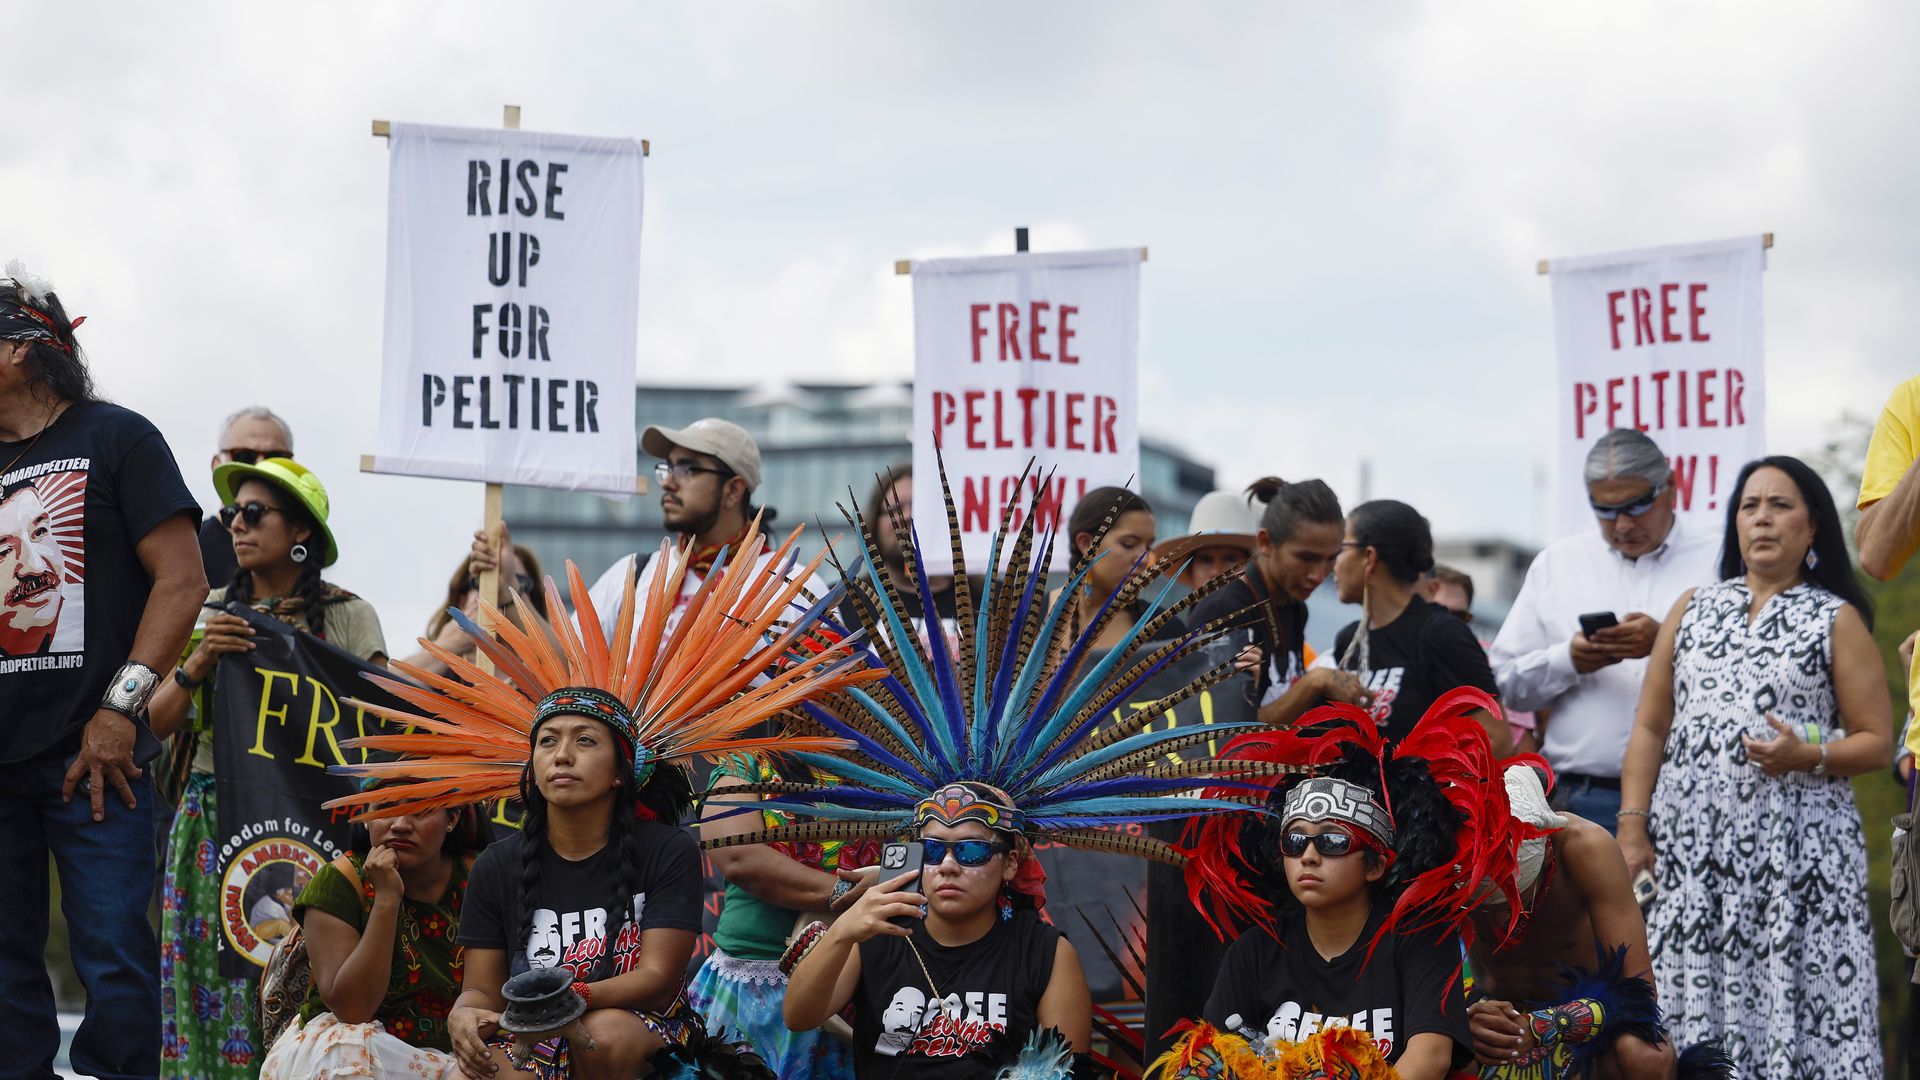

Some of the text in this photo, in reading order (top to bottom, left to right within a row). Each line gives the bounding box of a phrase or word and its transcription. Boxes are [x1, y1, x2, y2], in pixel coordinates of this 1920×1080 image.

[467, 159, 568, 220] RISE
[488, 232, 540, 288] UP
[472, 302, 551, 361] FOR
[970, 302, 1080, 364] FREE
[1608, 283, 1711, 350] FREE
[422, 373, 600, 433] PELTIER
[932, 388, 1118, 454] PELTIER
[1574, 368, 1746, 440] PELTIER
[0, 457, 90, 487] ONARDPELTIER
[1667, 455, 1718, 511] W!
[0, 655, 84, 674] RDPELTIER.INFO
[285, 817, 310, 838] for
[240, 843, 319, 877] AMERICA
[225, 885, 260, 953] INDIAN
